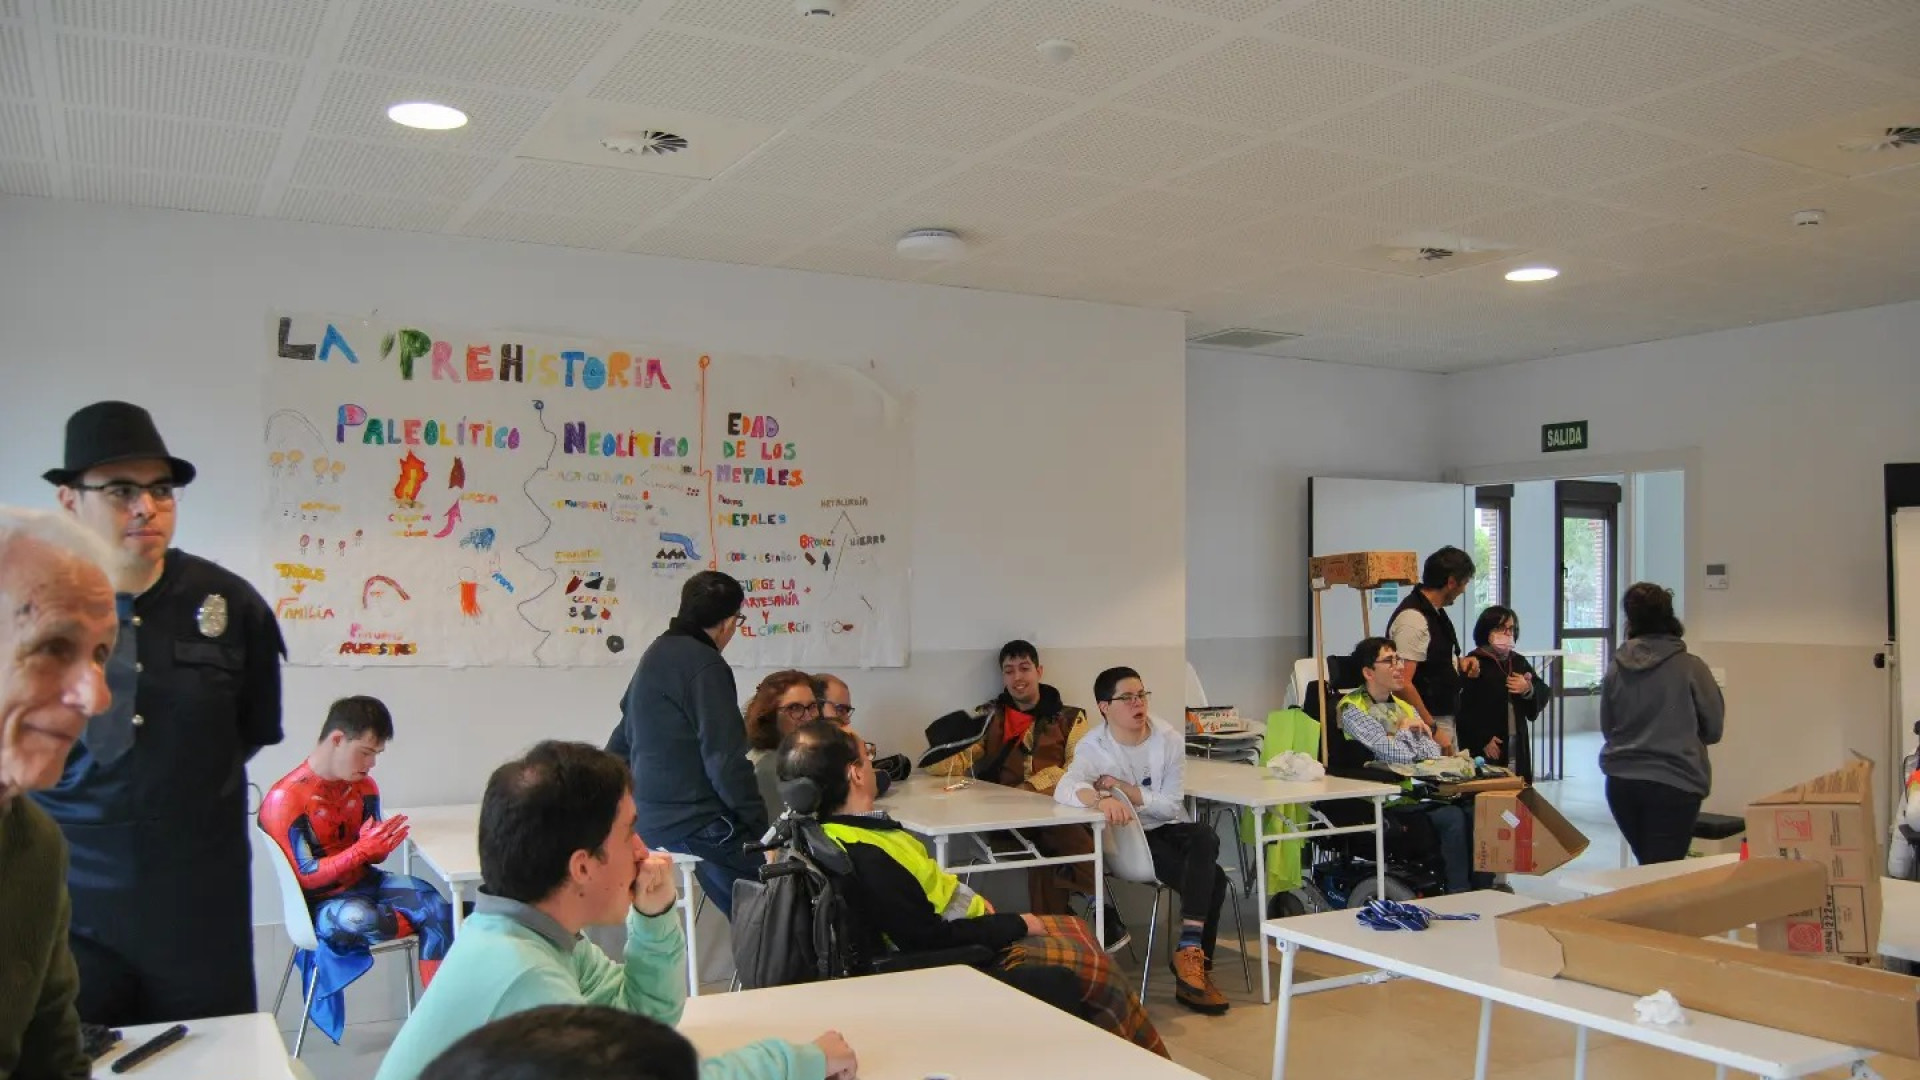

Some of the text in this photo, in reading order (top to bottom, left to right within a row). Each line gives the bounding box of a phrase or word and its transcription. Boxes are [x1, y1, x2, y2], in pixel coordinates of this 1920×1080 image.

[278, 317, 359, 363] LA
[728, 413, 779, 438] EDAD
[1547, 427, 1582, 447] SALIDA
[723, 440, 797, 461] DE LOS
[716, 464, 804, 487] METALES
[718, 512, 786, 527] METALES
[800, 534, 835, 550] BRONCE
[782, 578, 796, 590] LA
[762, 610, 769, 624] Y
[741, 626, 757, 637] EL
